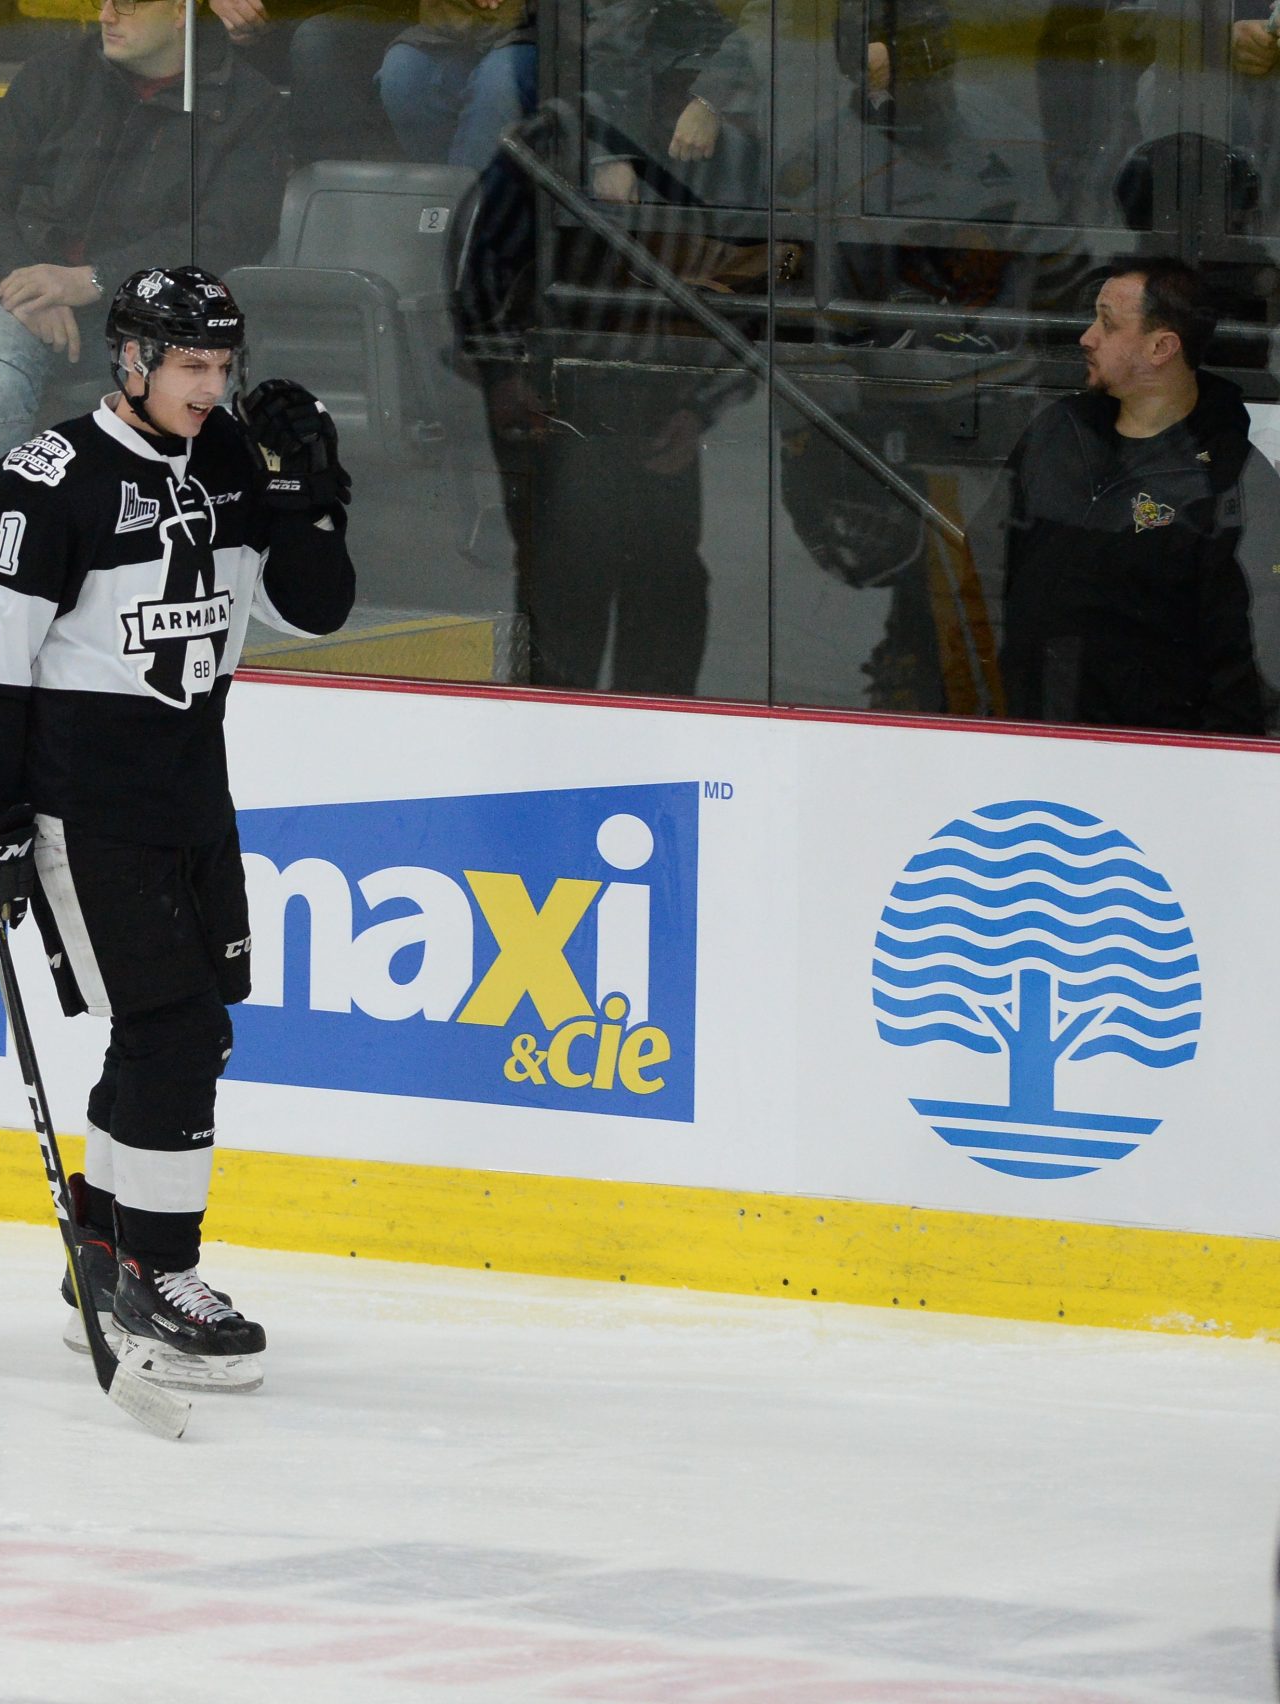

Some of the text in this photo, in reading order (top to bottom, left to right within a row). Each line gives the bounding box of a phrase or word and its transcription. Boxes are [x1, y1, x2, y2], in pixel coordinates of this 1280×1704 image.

[428, 211, 439, 229] 2
[207, 319, 238, 328] CCM
[203, 491, 243, 506] CCM
[152, 604, 227, 631] ARMADA
[704, 781, 733, 800] MD
[240, 813, 654, 1031] maxi
[24, 1082, 69, 1220] CCM
